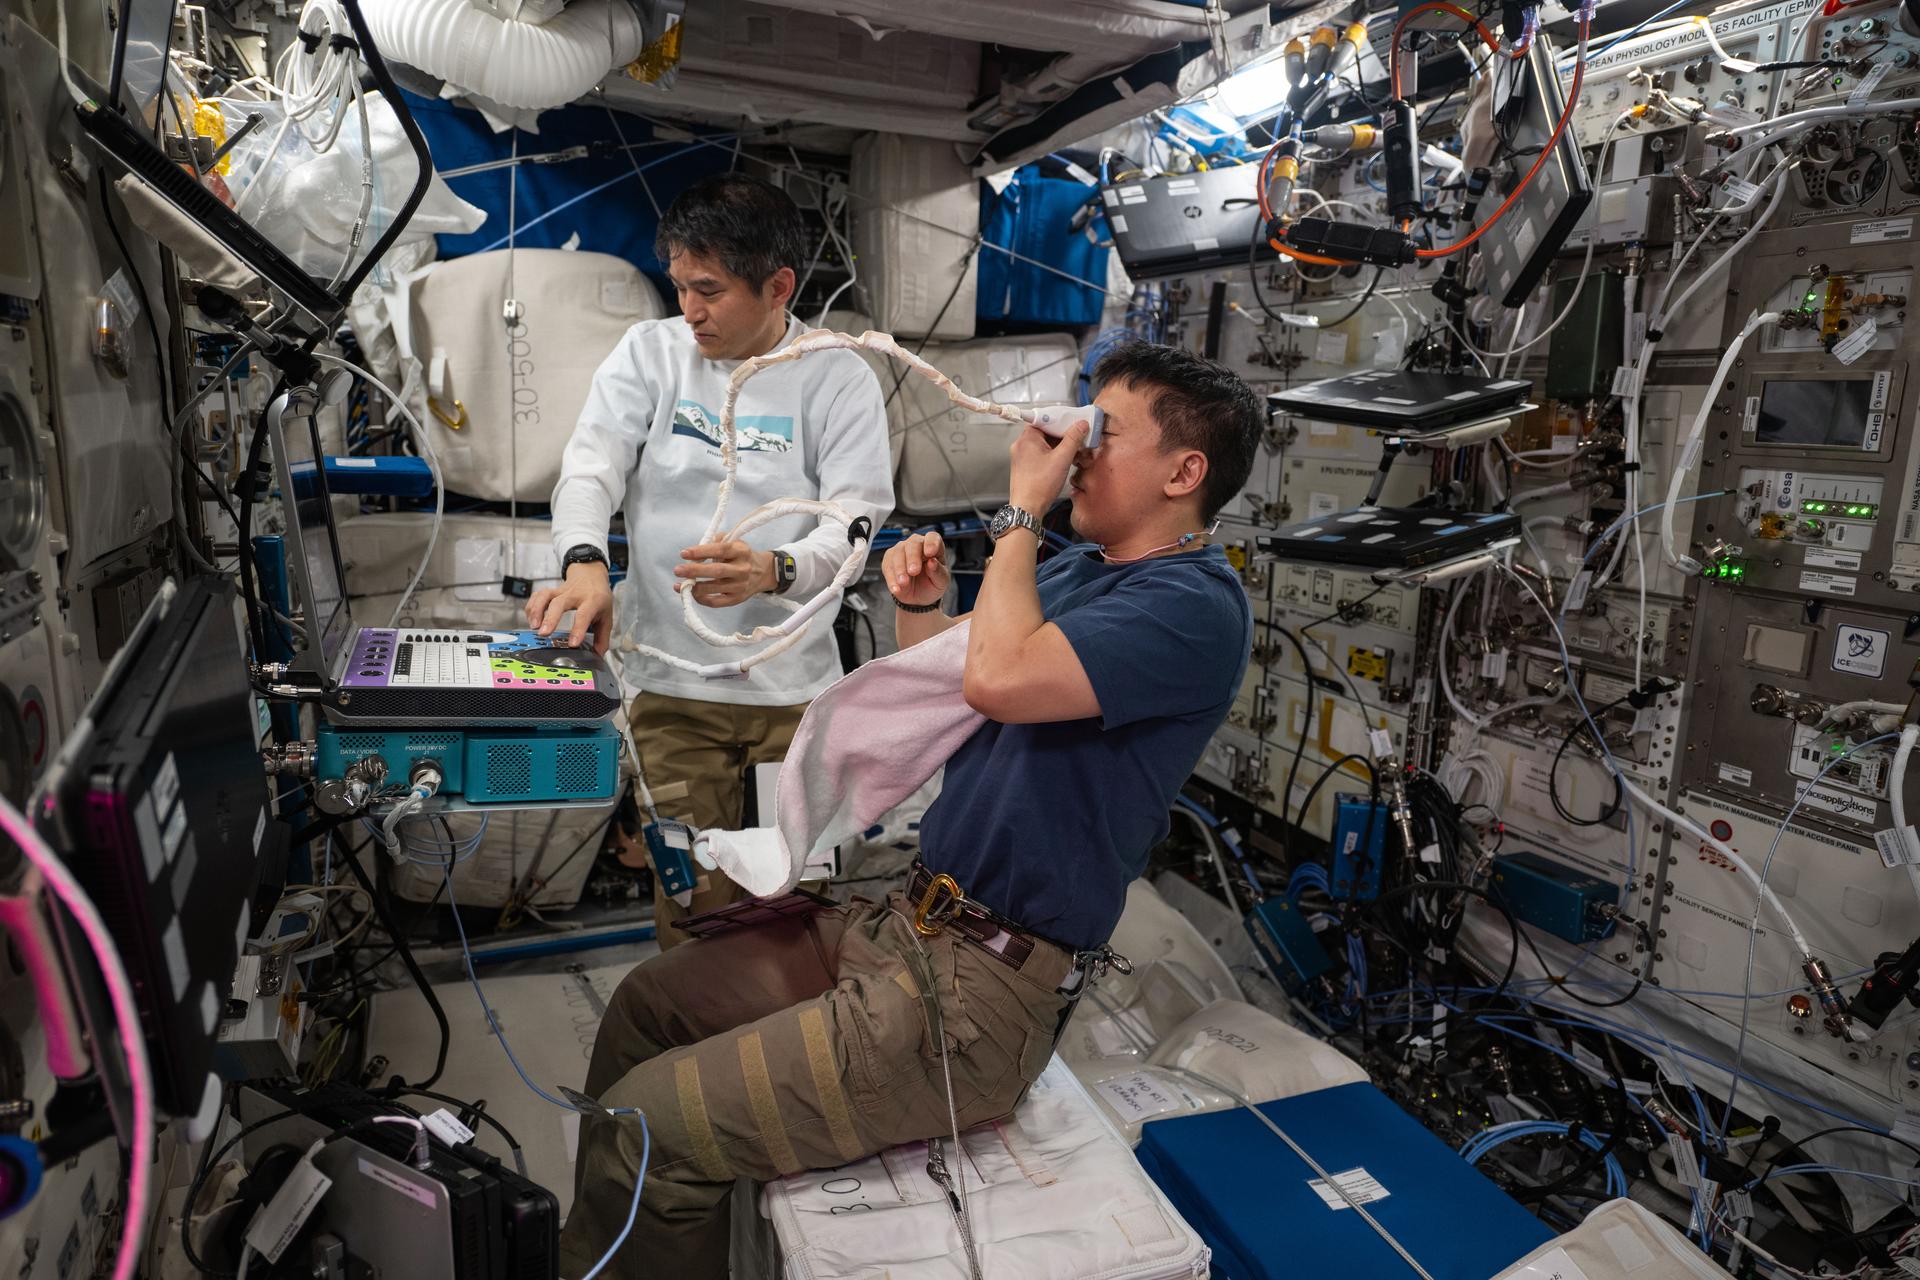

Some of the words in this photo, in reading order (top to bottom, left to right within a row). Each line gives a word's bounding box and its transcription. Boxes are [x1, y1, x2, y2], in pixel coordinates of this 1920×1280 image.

[1615, 36, 1677, 65] PHYSIOLOGY
[1678, 23, 1730, 45] MODUES
[1731, 7, 1783, 30] FACILITY
[1784, 0, 1818, 17] (EPM)
[1876, 373, 1886, 399] SINTEF
[1870, 413, 1882, 442] OHB
[1782, 472, 1793, 496] esa
[1712, 801, 1730, 813] DATA
[1730, 805, 1777, 827] MANAGEMENT
[1777, 822, 1805, 837] SSTEM
[1805, 829, 1835, 847] ACCESS
[1836, 837, 1862, 855] PANEL
[1675, 895, 1701, 912] FACILITY
[1701, 905, 1728, 922] SERVICE
[1728, 914, 1750, 930] PANEL
